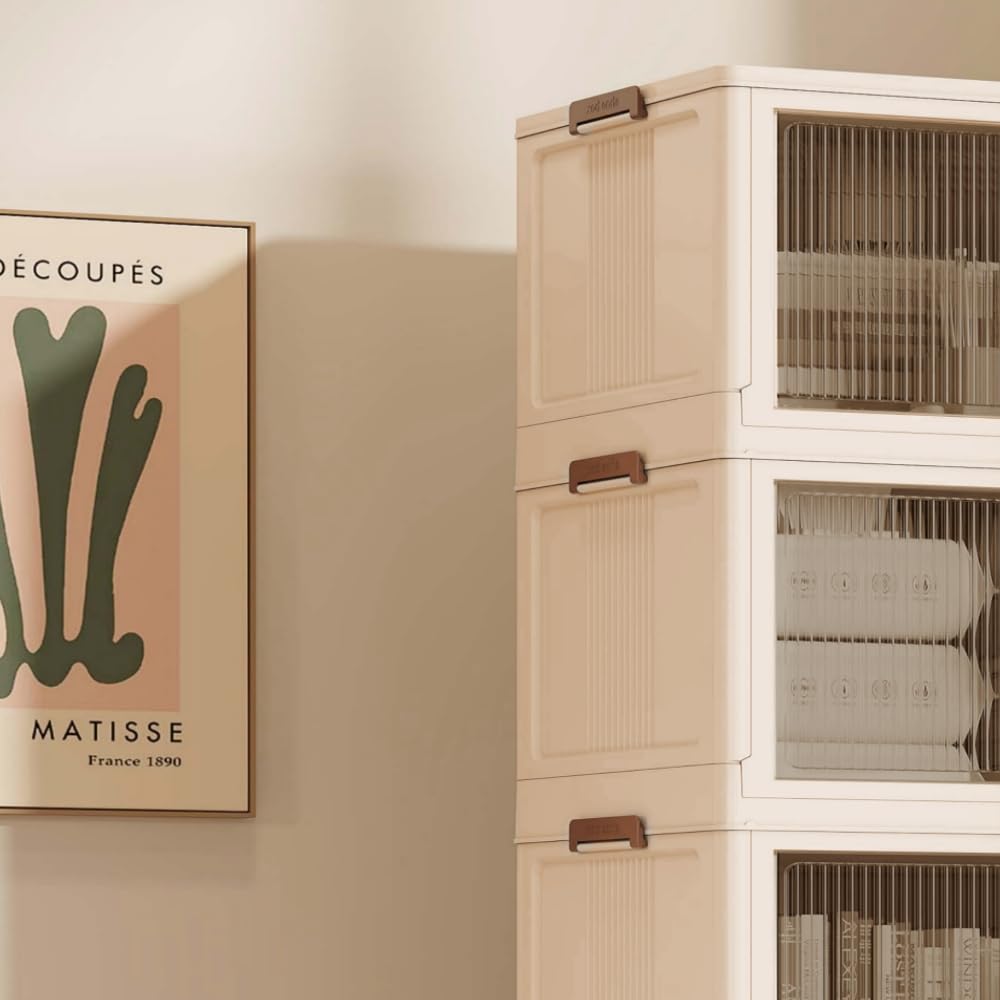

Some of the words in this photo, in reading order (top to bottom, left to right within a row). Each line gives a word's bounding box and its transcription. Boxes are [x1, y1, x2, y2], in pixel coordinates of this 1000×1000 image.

[31, 719, 184, 743] MATISSE
[88, 755, 141, 767] France
[147, 756, 182, 768] 1890
